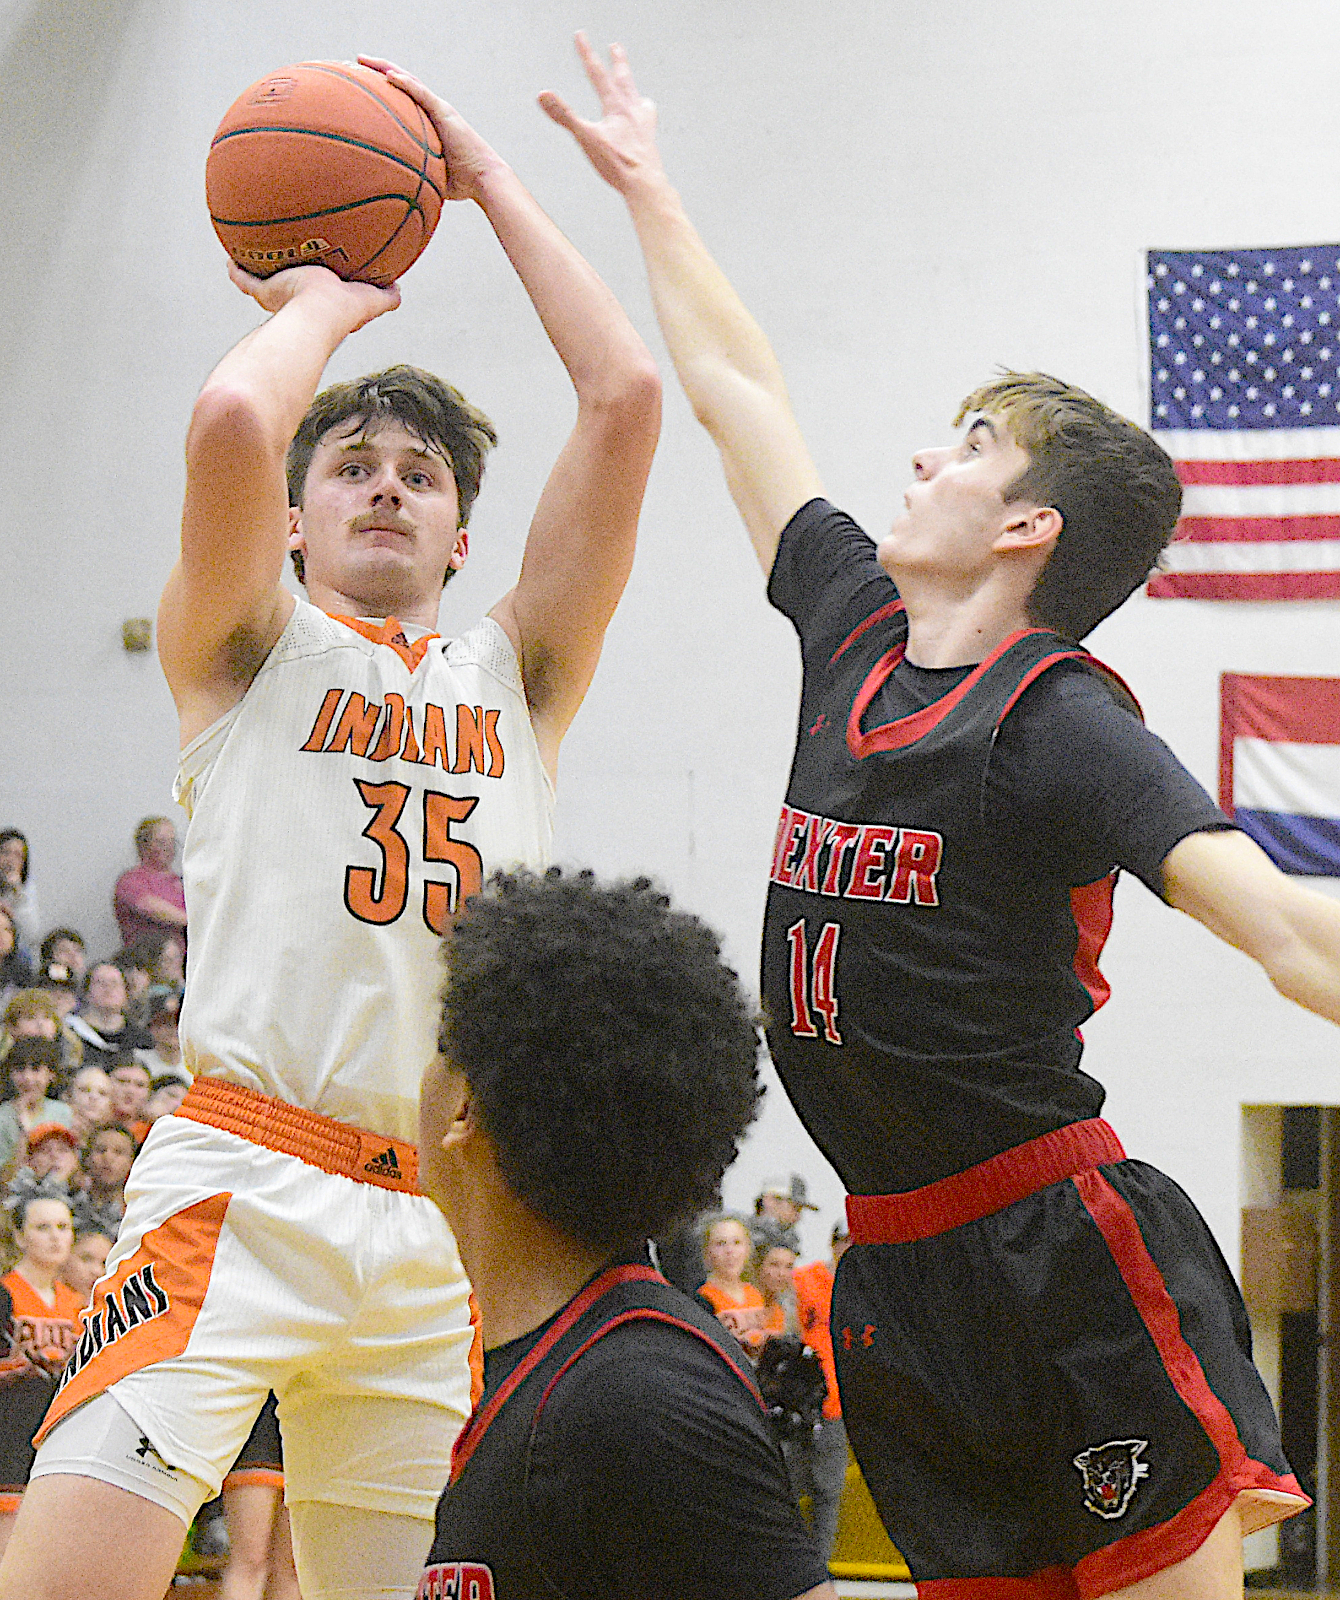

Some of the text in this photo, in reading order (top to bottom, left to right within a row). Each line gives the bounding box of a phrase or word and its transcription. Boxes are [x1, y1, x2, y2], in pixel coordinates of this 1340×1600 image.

[299, 688, 505, 779] INDIANS
[343, 777, 485, 936] 35
[787, 918, 843, 1046] 14
[364, 1163, 402, 1180] adidas
